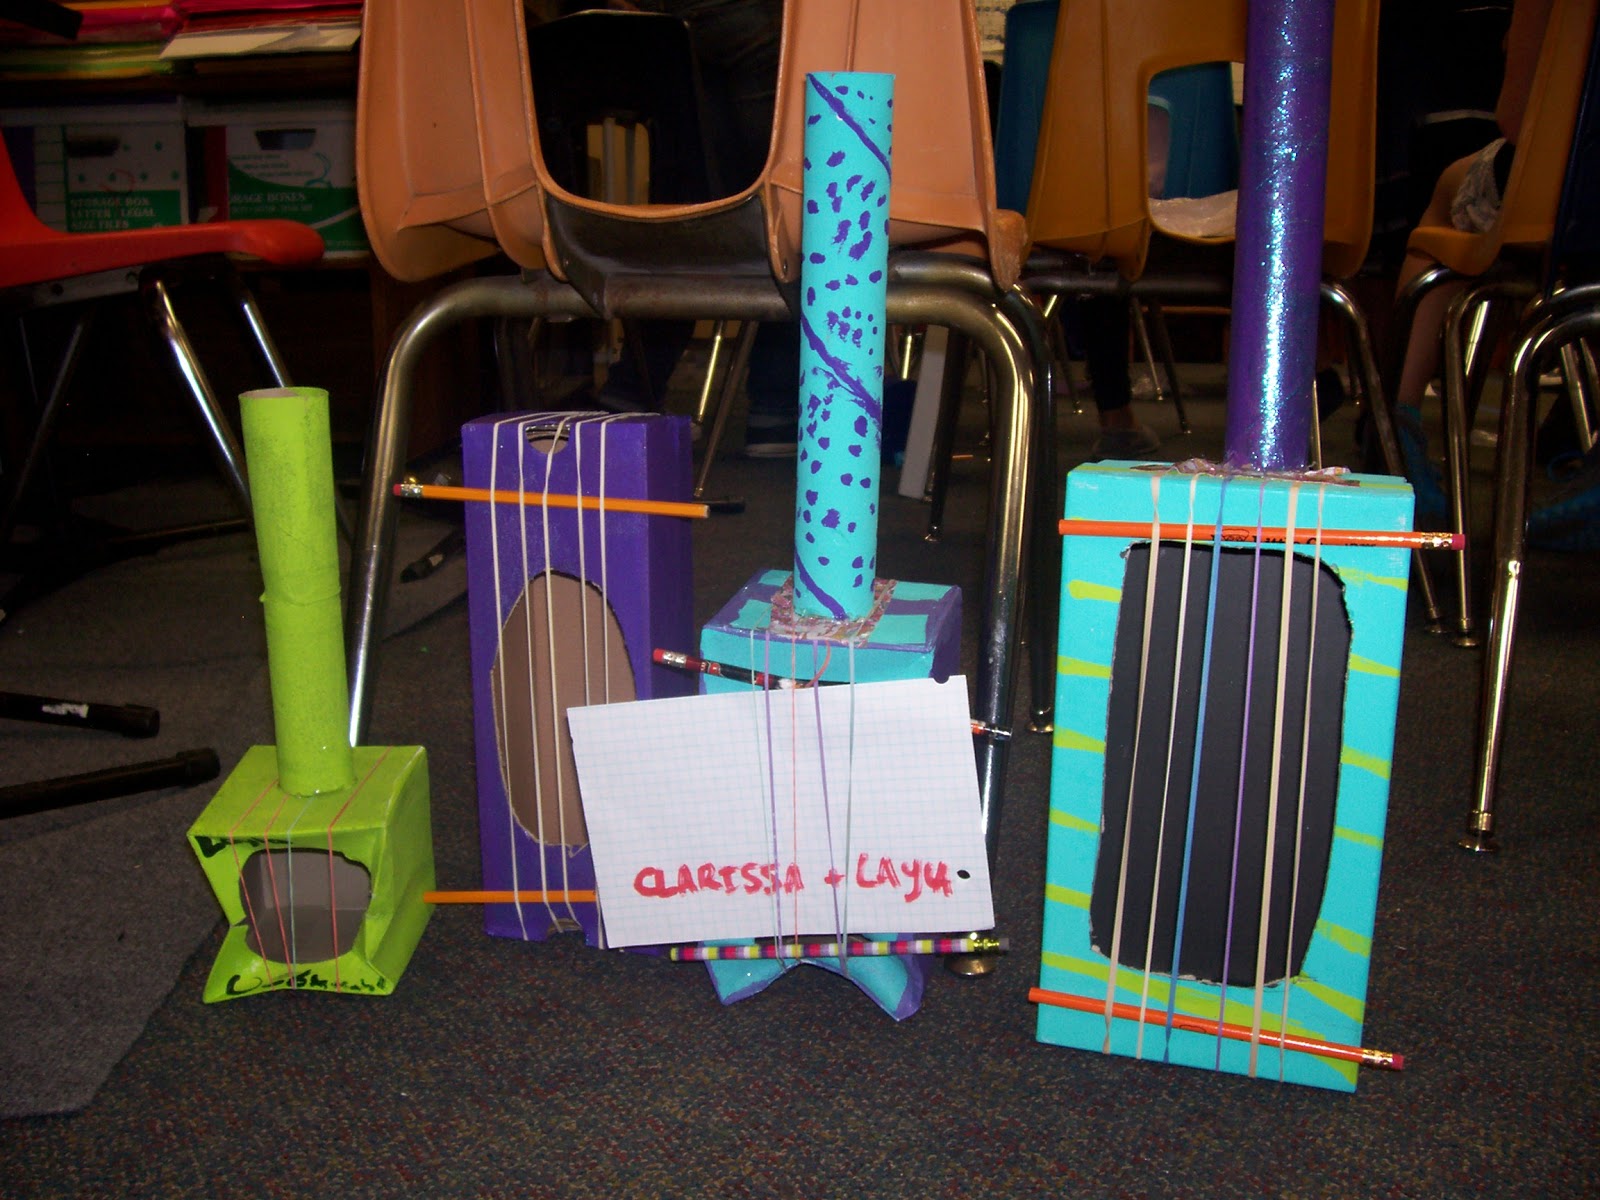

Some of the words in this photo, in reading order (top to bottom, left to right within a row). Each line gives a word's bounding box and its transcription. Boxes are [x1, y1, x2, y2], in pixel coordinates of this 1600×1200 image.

[125, 196, 151, 206] BOX
[267, 191, 306, 202] BOXES
[633, 862, 805, 898] CLARISSA
